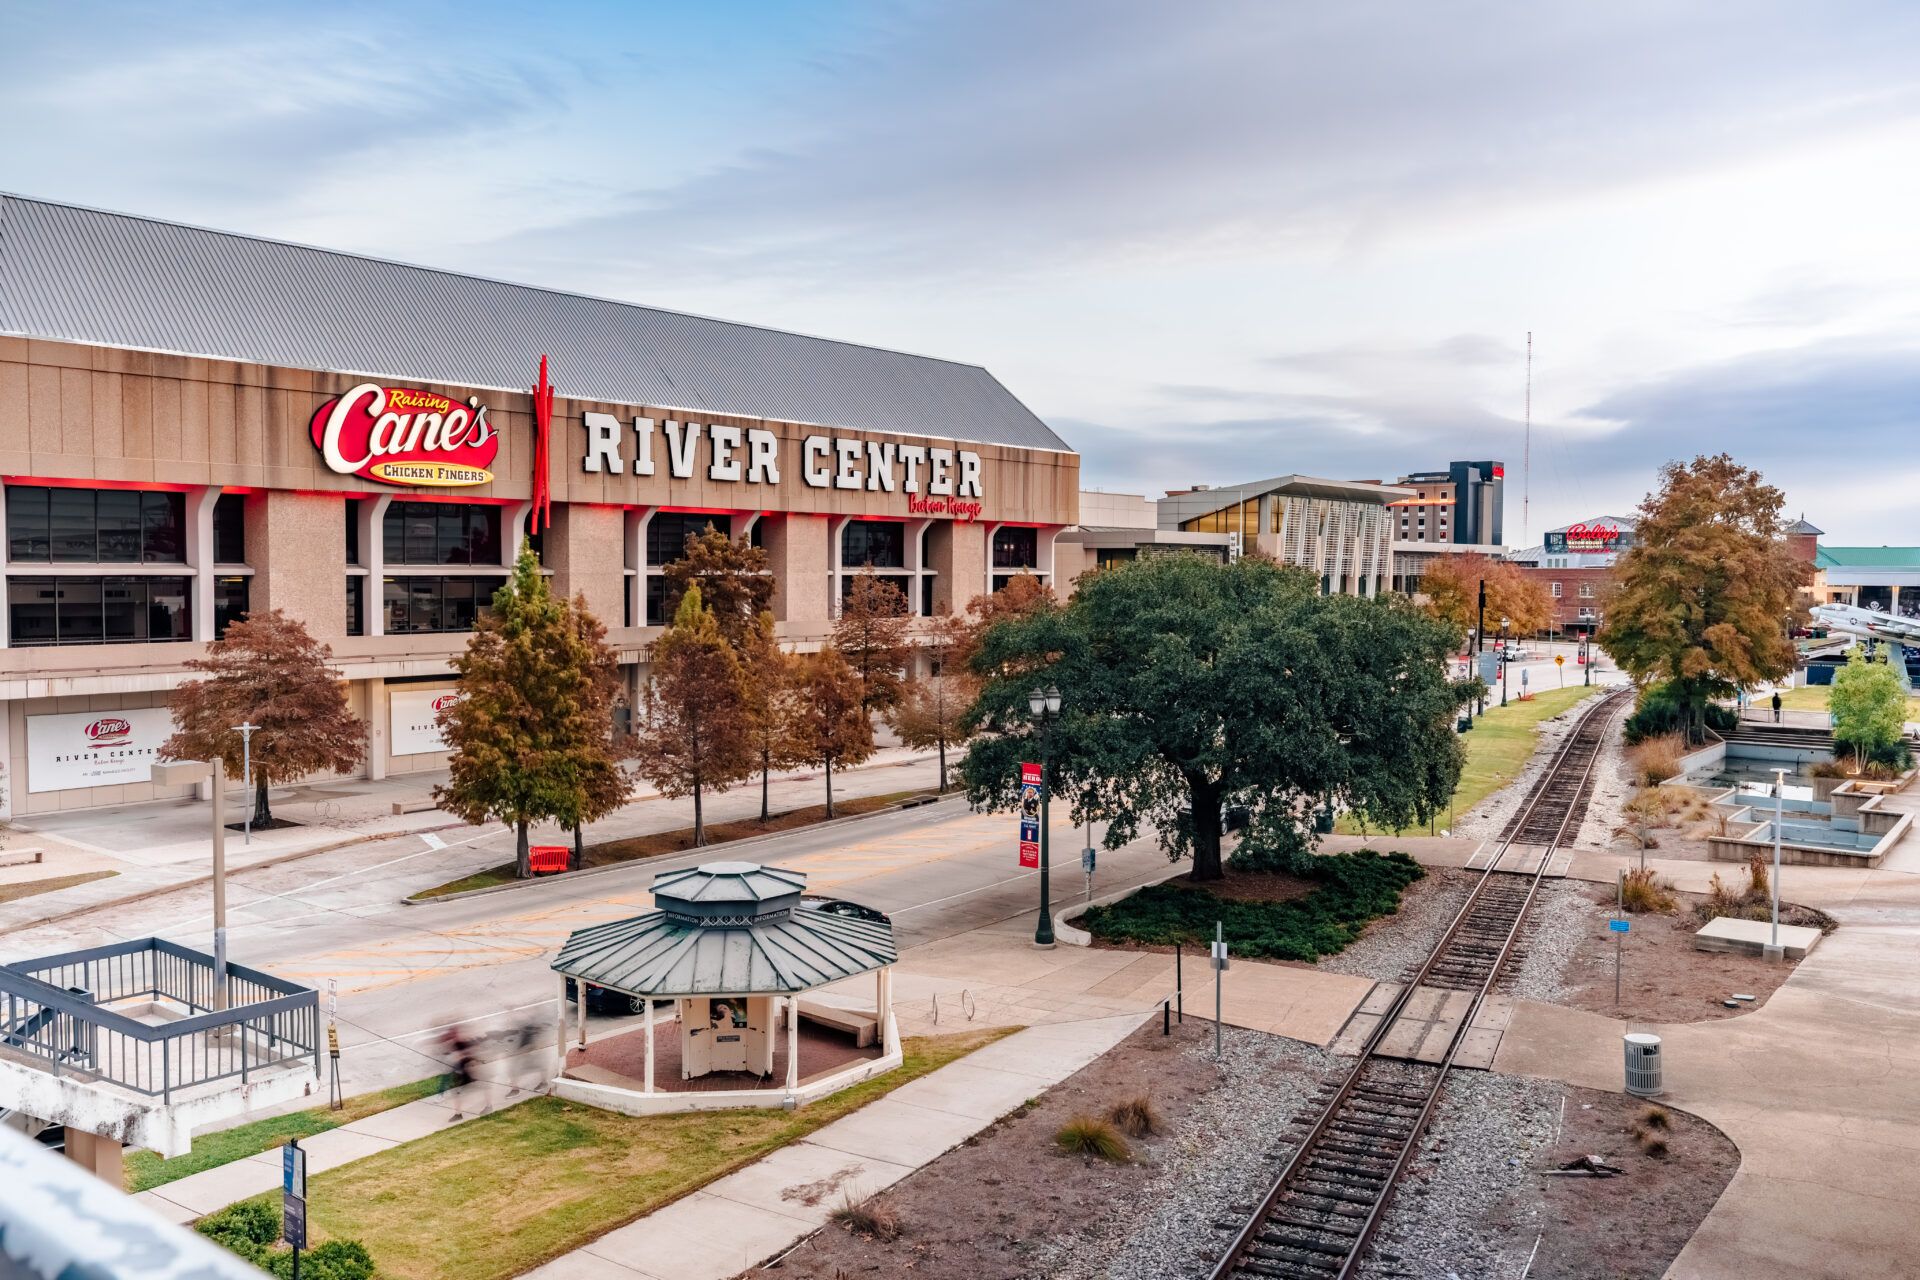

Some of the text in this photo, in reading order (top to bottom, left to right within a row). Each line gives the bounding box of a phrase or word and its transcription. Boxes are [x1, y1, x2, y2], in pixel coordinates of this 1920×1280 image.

[389, 391, 449, 414] Raising
[323, 383, 500, 474] Cane's
[583, 411, 983, 498] RIVER CENTER
[384, 464, 485, 482] CHICKEN FINGERS
[909, 493, 983, 523] Baton Rouge
[1566, 523, 1618, 543] Bally's
[87, 719, 130, 740] Cane's
[56, 753, 98, 762] RIVER
